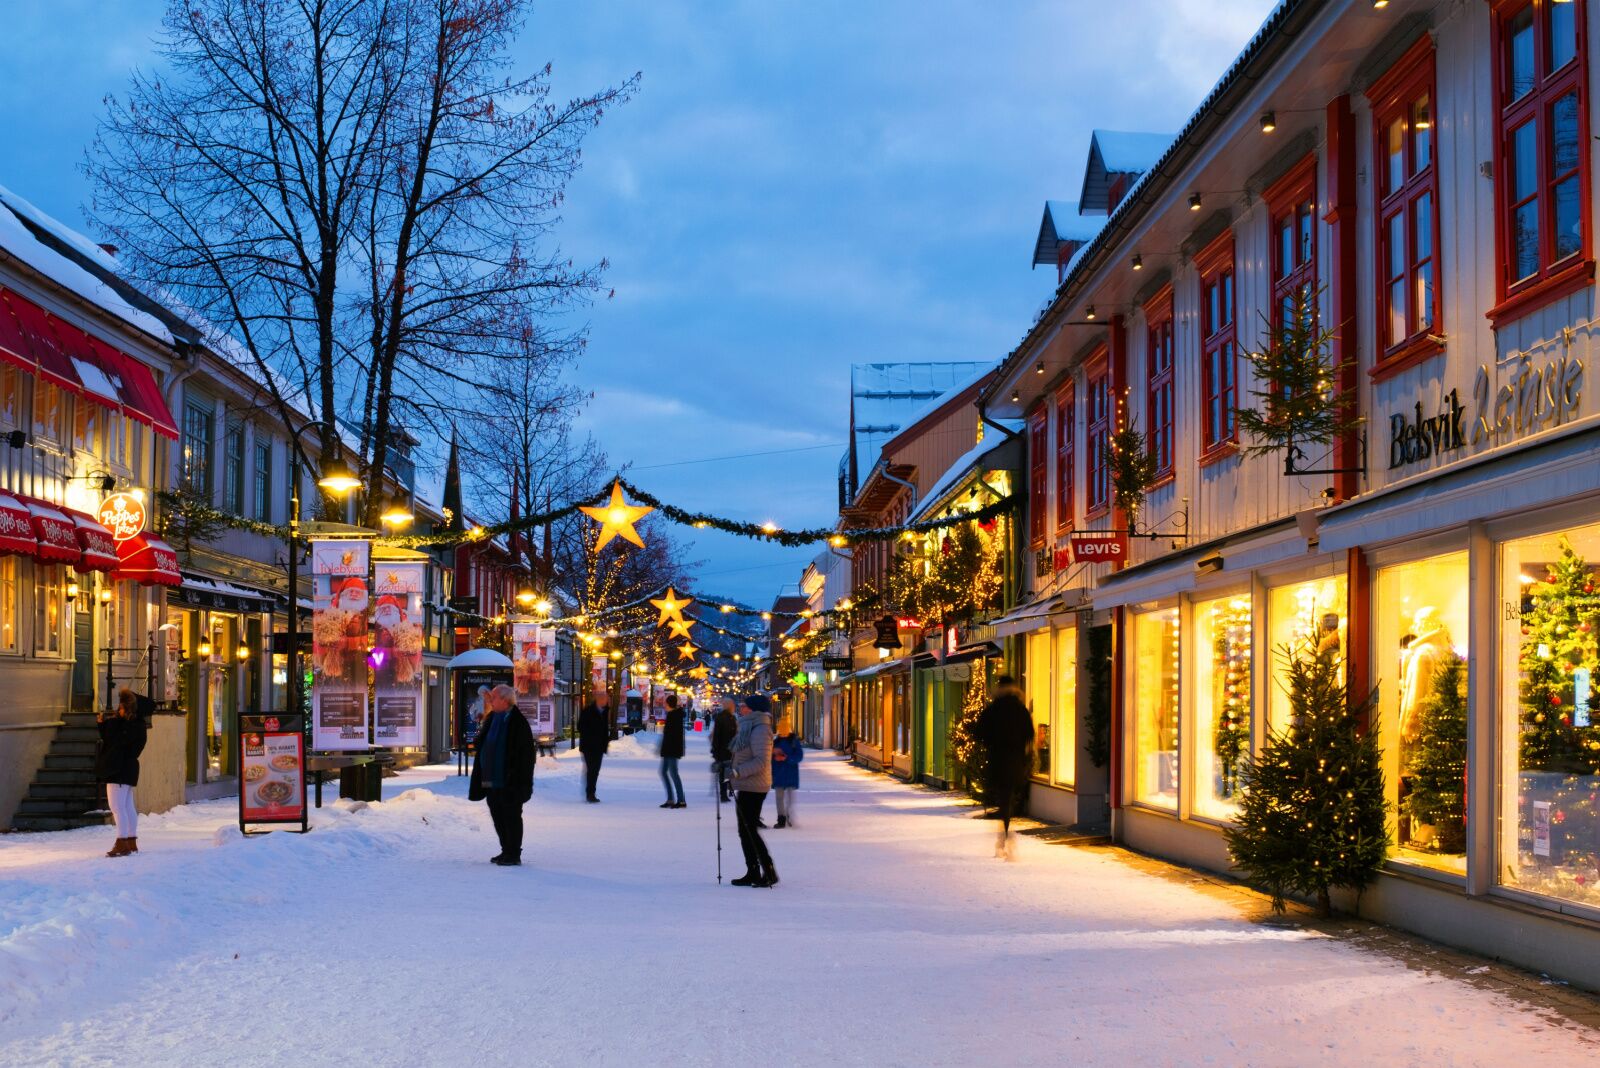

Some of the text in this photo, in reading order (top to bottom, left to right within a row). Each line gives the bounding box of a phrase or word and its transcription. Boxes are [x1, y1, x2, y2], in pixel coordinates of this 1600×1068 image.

[1388, 388, 1466, 469] Belsvik
[102, 510, 140, 526] Peppes
[320, 563, 365, 575] Julebyen
